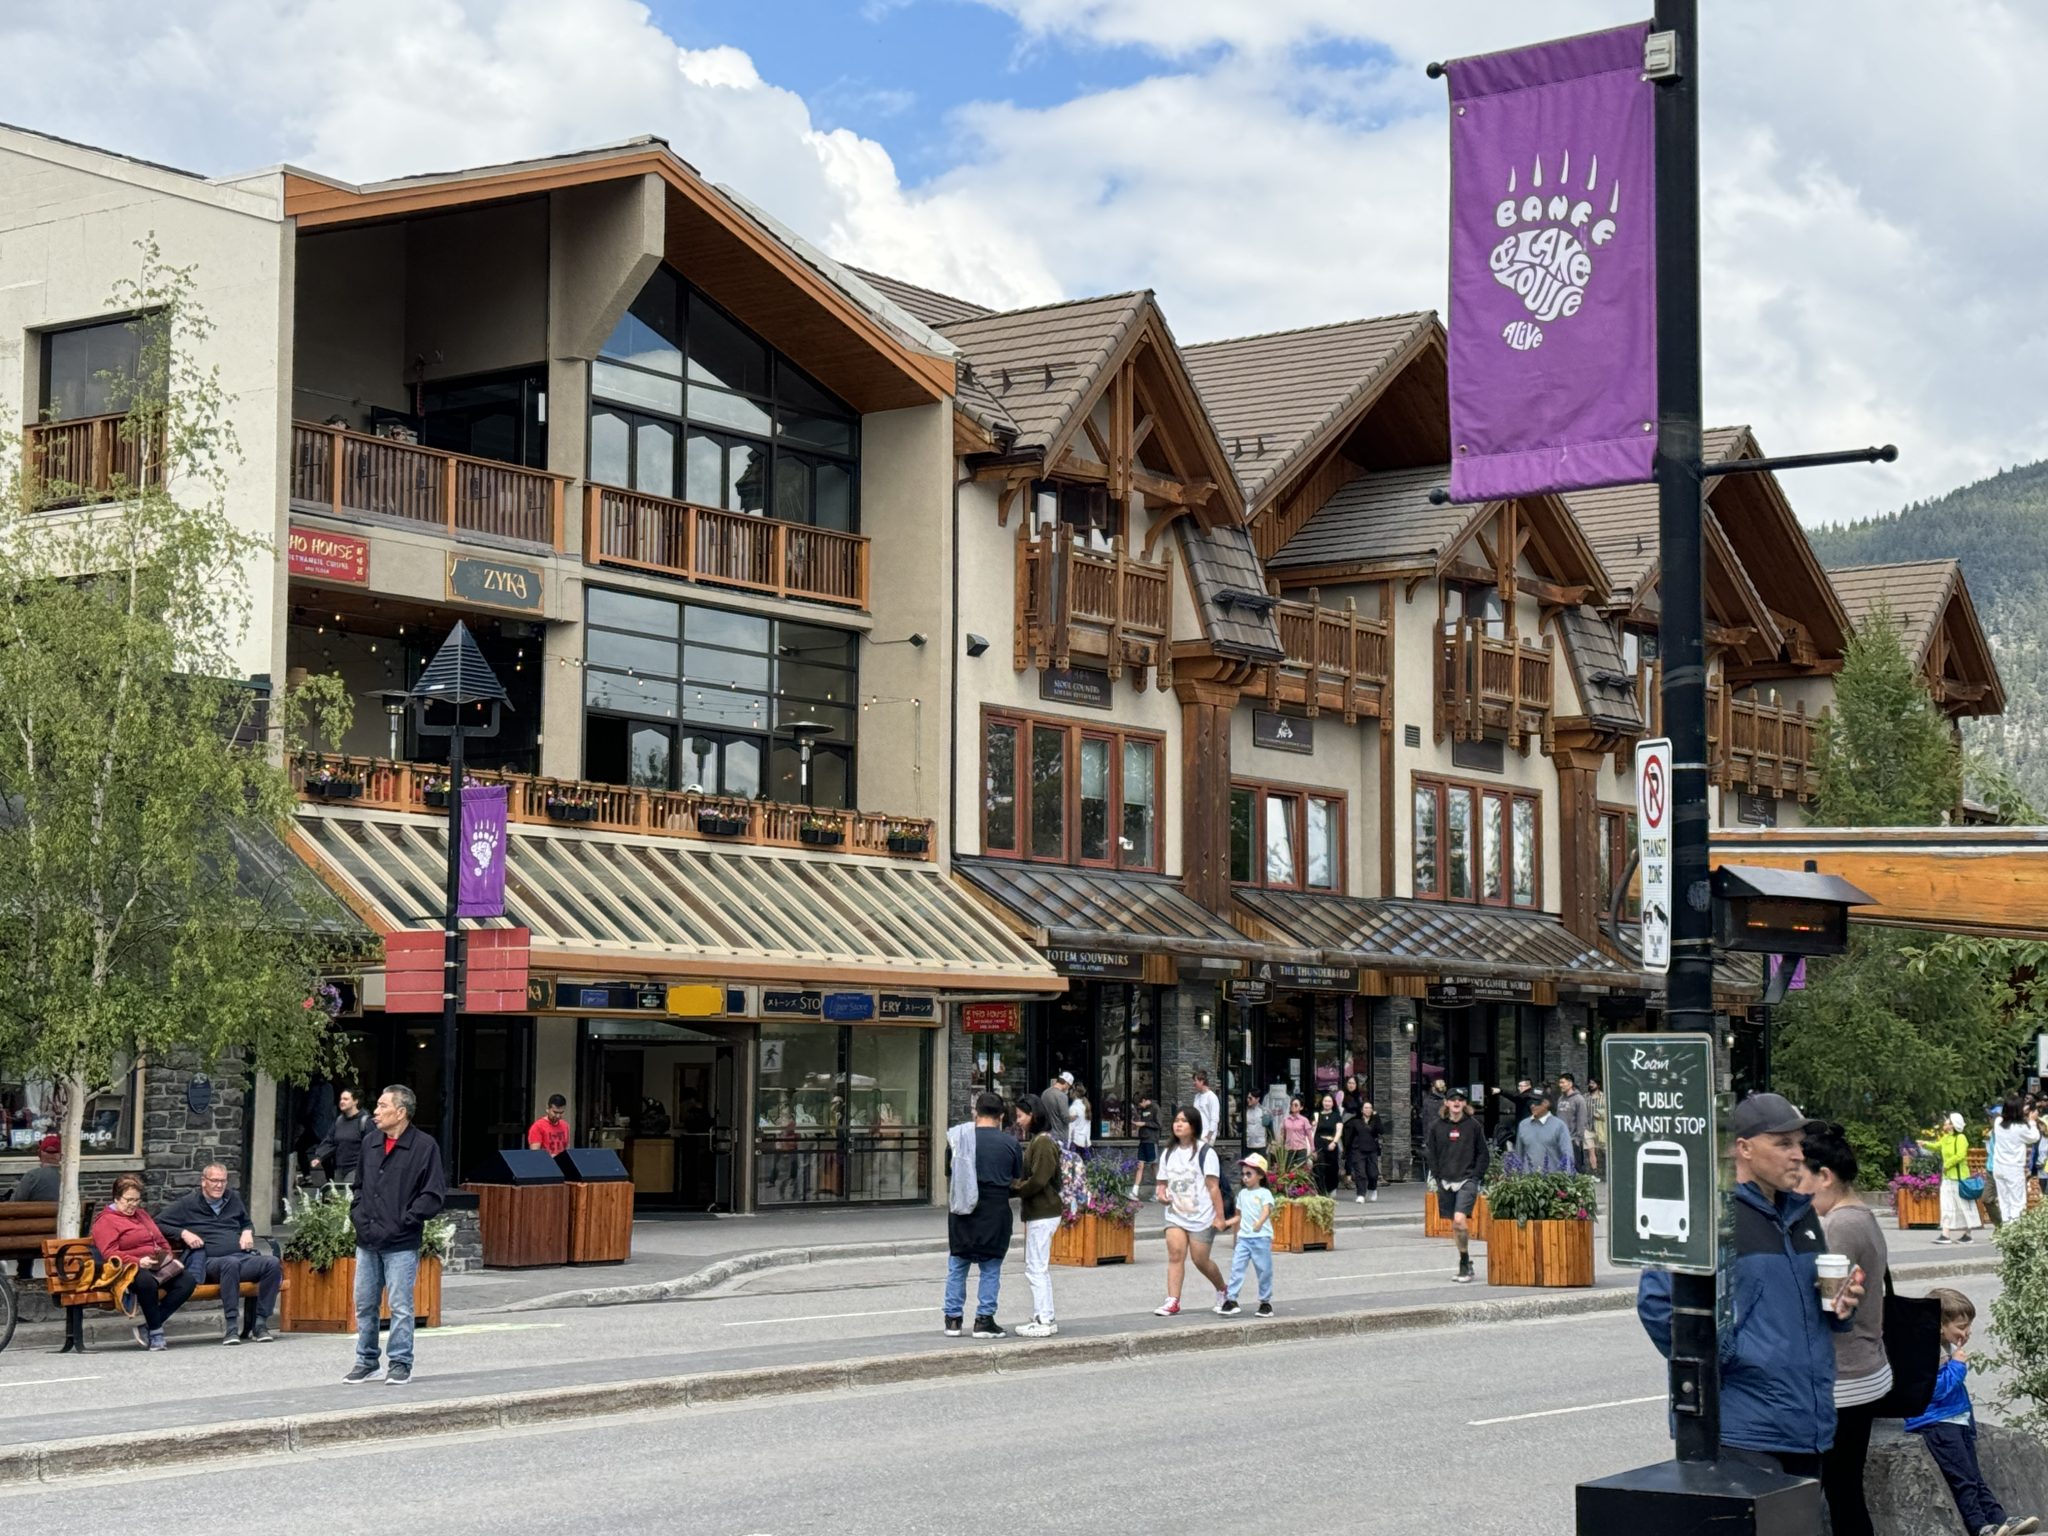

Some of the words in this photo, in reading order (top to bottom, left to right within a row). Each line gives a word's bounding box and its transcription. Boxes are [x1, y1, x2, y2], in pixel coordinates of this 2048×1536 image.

[1496, 195, 1616, 245] BANFF
[289, 535, 307, 552] HO
[312, 538, 354, 560] HOUSE
[484, 568, 527, 600] ZYKA
[1045, 949, 1077, 962] TOTEM
[1079, 952, 1129, 966] SOUVENIRS
[1279, 965, 1295, 977] THE
[800, 996, 821, 1010] STO
[1631, 1049, 1669, 1071] Roam
[1638, 1091, 1684, 1110] PUBLIC
[1614, 1114, 1671, 1134] TRANSIT
[1674, 1116, 1706, 1135] STOP
[15, 1131, 31, 1144] Big
[98, 1130, 112, 1140] Co
